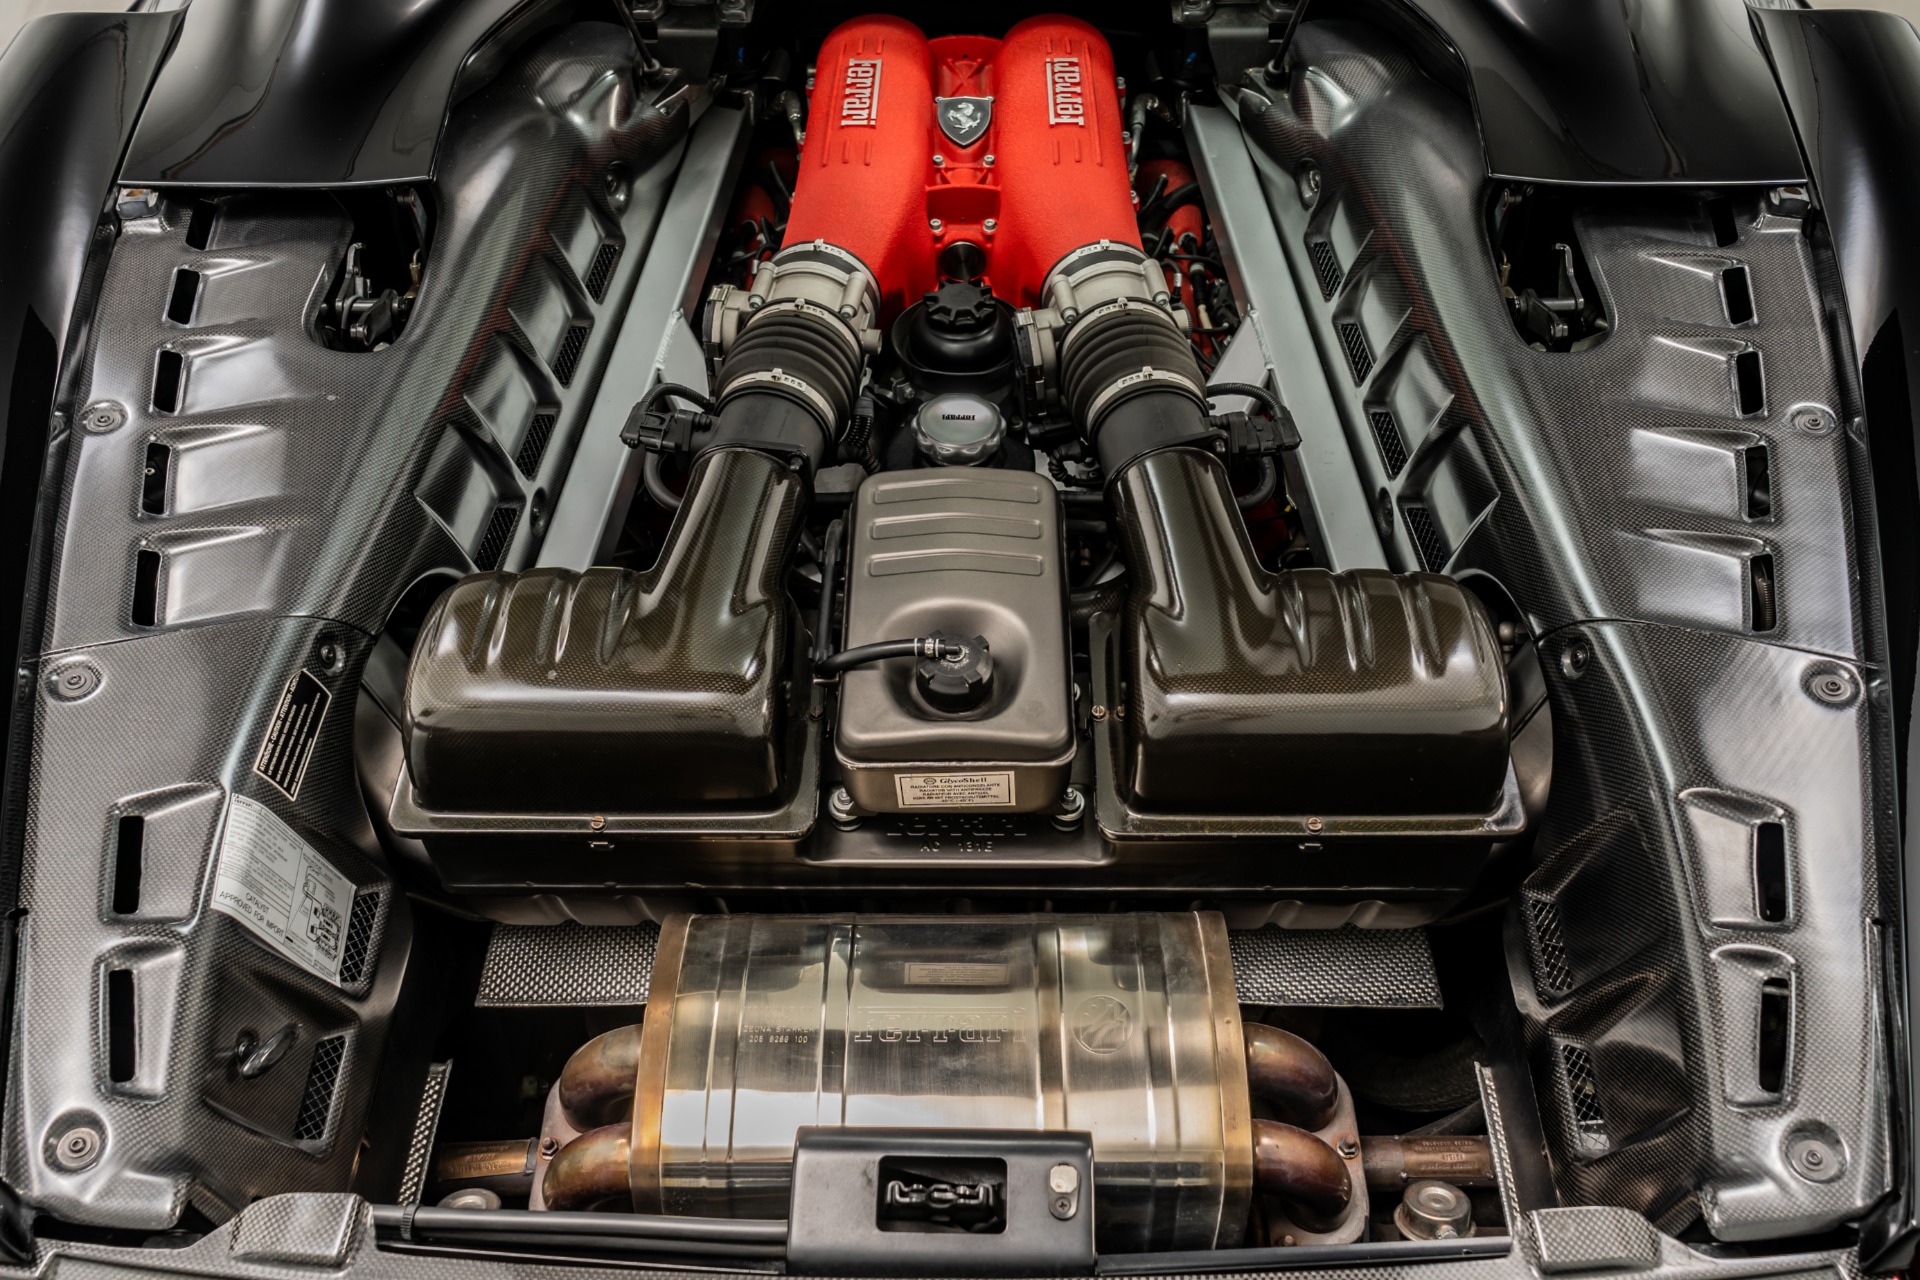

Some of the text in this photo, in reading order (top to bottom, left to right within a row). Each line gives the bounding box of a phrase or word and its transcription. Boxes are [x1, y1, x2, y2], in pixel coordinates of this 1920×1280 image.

[841, 58, 882, 126] Ferrari
[1046, 57, 1084, 126] Ferrari
[271, 719, 282, 741] CAUTION
[280, 693, 292, 718] ATTENTION
[219, 890, 285, 937] APPROVED FOR IMPORT
[245, 892, 270, 914] CATALYST
[795, 1035, 808, 1043] 100
[854, 1006, 1026, 1042] Ferrari
